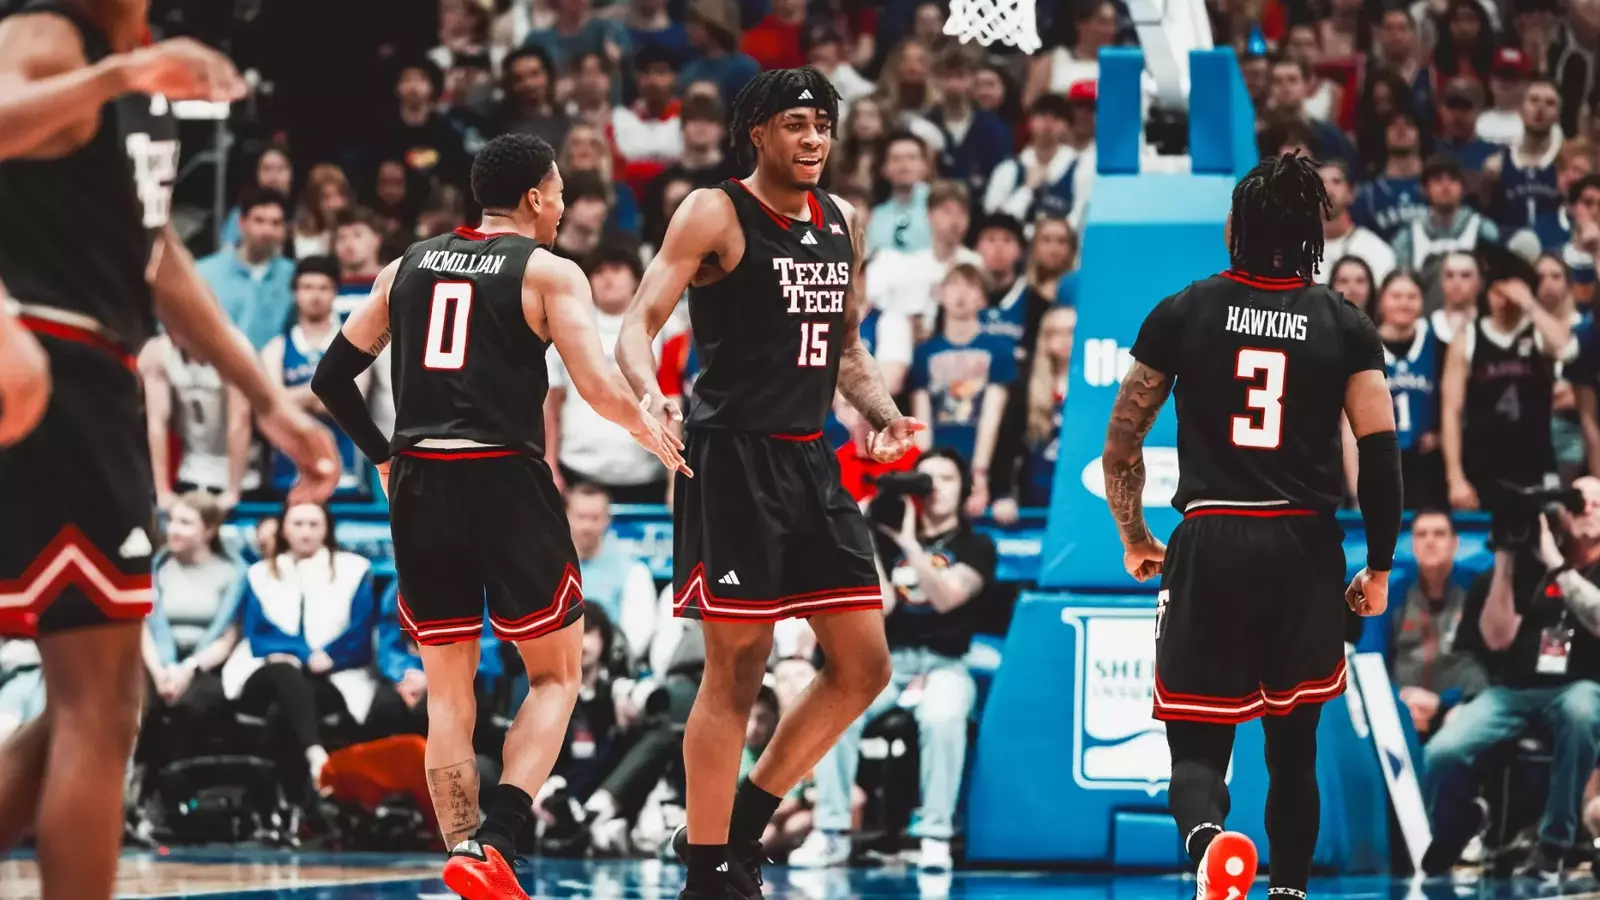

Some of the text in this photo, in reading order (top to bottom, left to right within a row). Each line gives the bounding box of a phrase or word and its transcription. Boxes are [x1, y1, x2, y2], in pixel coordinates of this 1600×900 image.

[417, 250, 506, 275] MCMILLIAN
[772, 257, 850, 286] TEXAS
[782, 285, 846, 314] TECH
[422, 280, 474, 371] 0
[1225, 305, 1308, 341] HAWKINS
[797, 322, 831, 368] 15
[1230, 346, 1288, 450] 3
[1094, 659, 1155, 679] SHE
